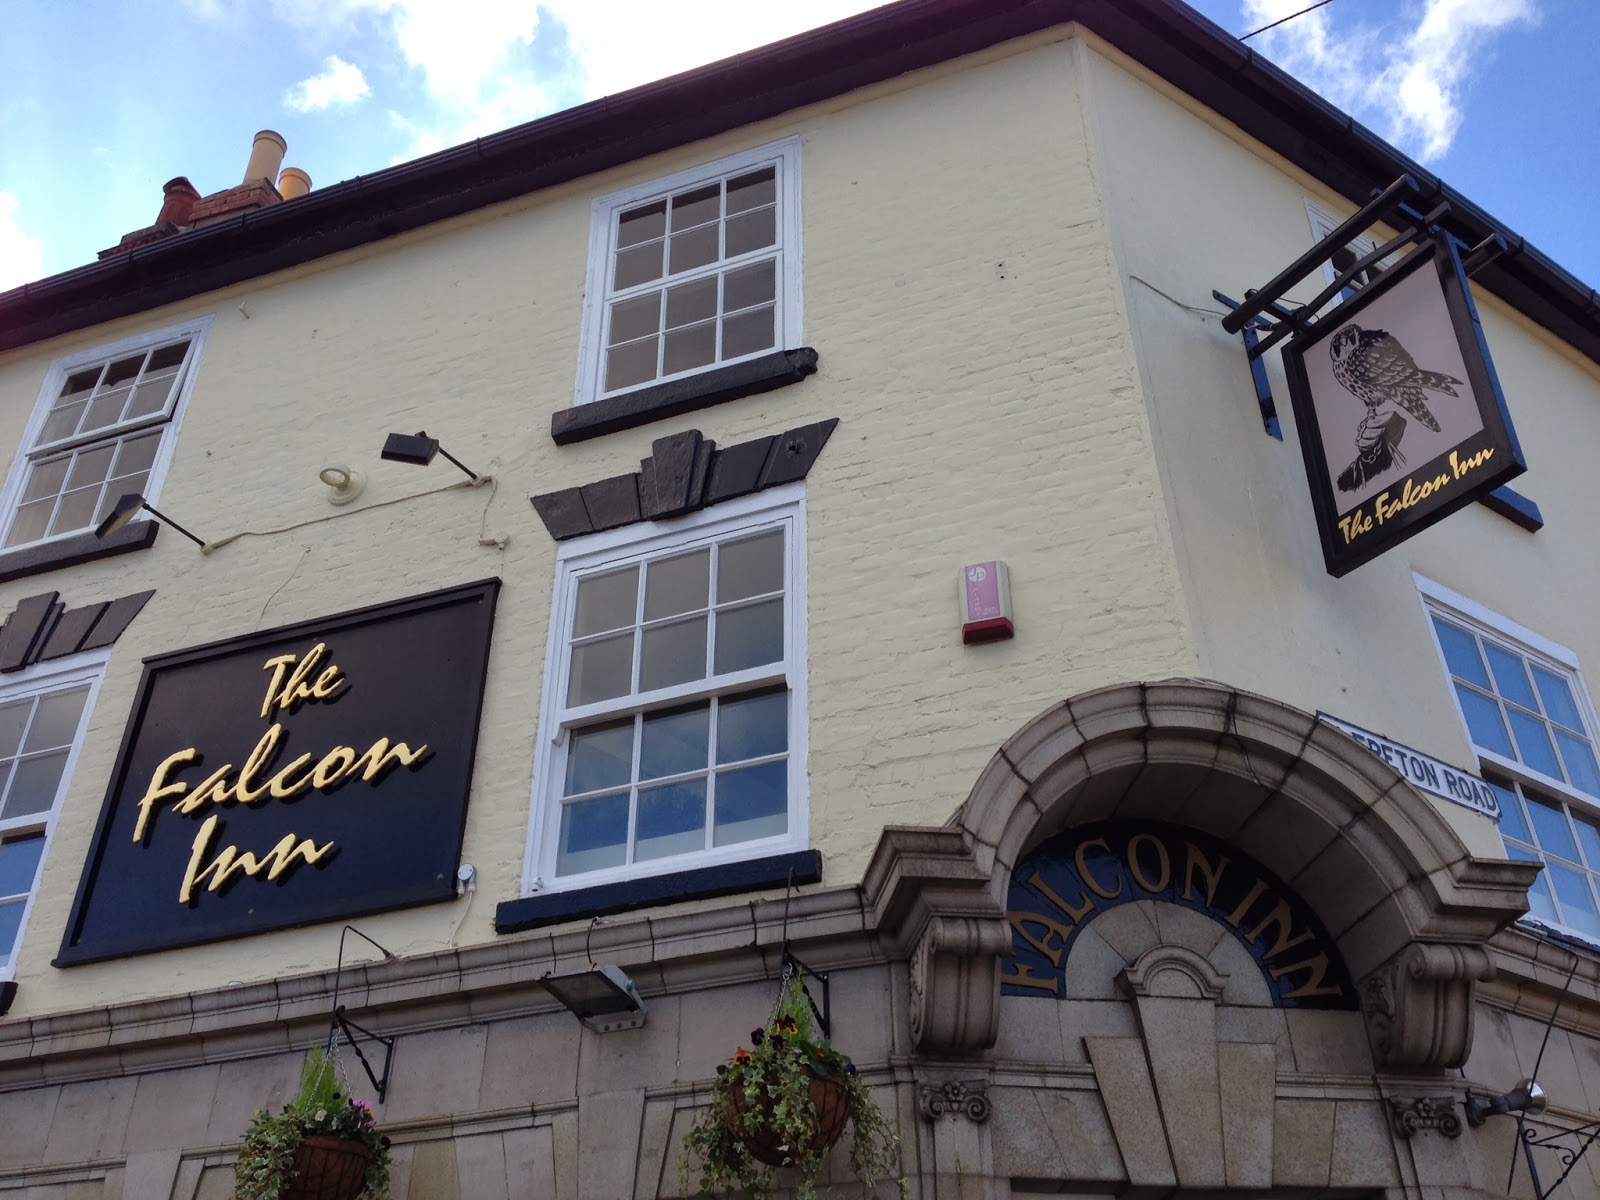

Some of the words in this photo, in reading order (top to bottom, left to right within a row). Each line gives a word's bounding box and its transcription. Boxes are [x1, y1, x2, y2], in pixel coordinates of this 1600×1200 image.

[1338, 509, 1373, 545] The
[1375, 479, 1450, 526] Falcon
[1449, 447, 1495, 480] Inn
[260, 642, 346, 718] The
[132, 723, 429, 843] Falcon
[1443, 769, 1497, 812] ROAD
[179, 815, 335, 904] Inn
[1000, 833, 1232, 995] FALCON
[1224, 878, 1344, 1000] INN
